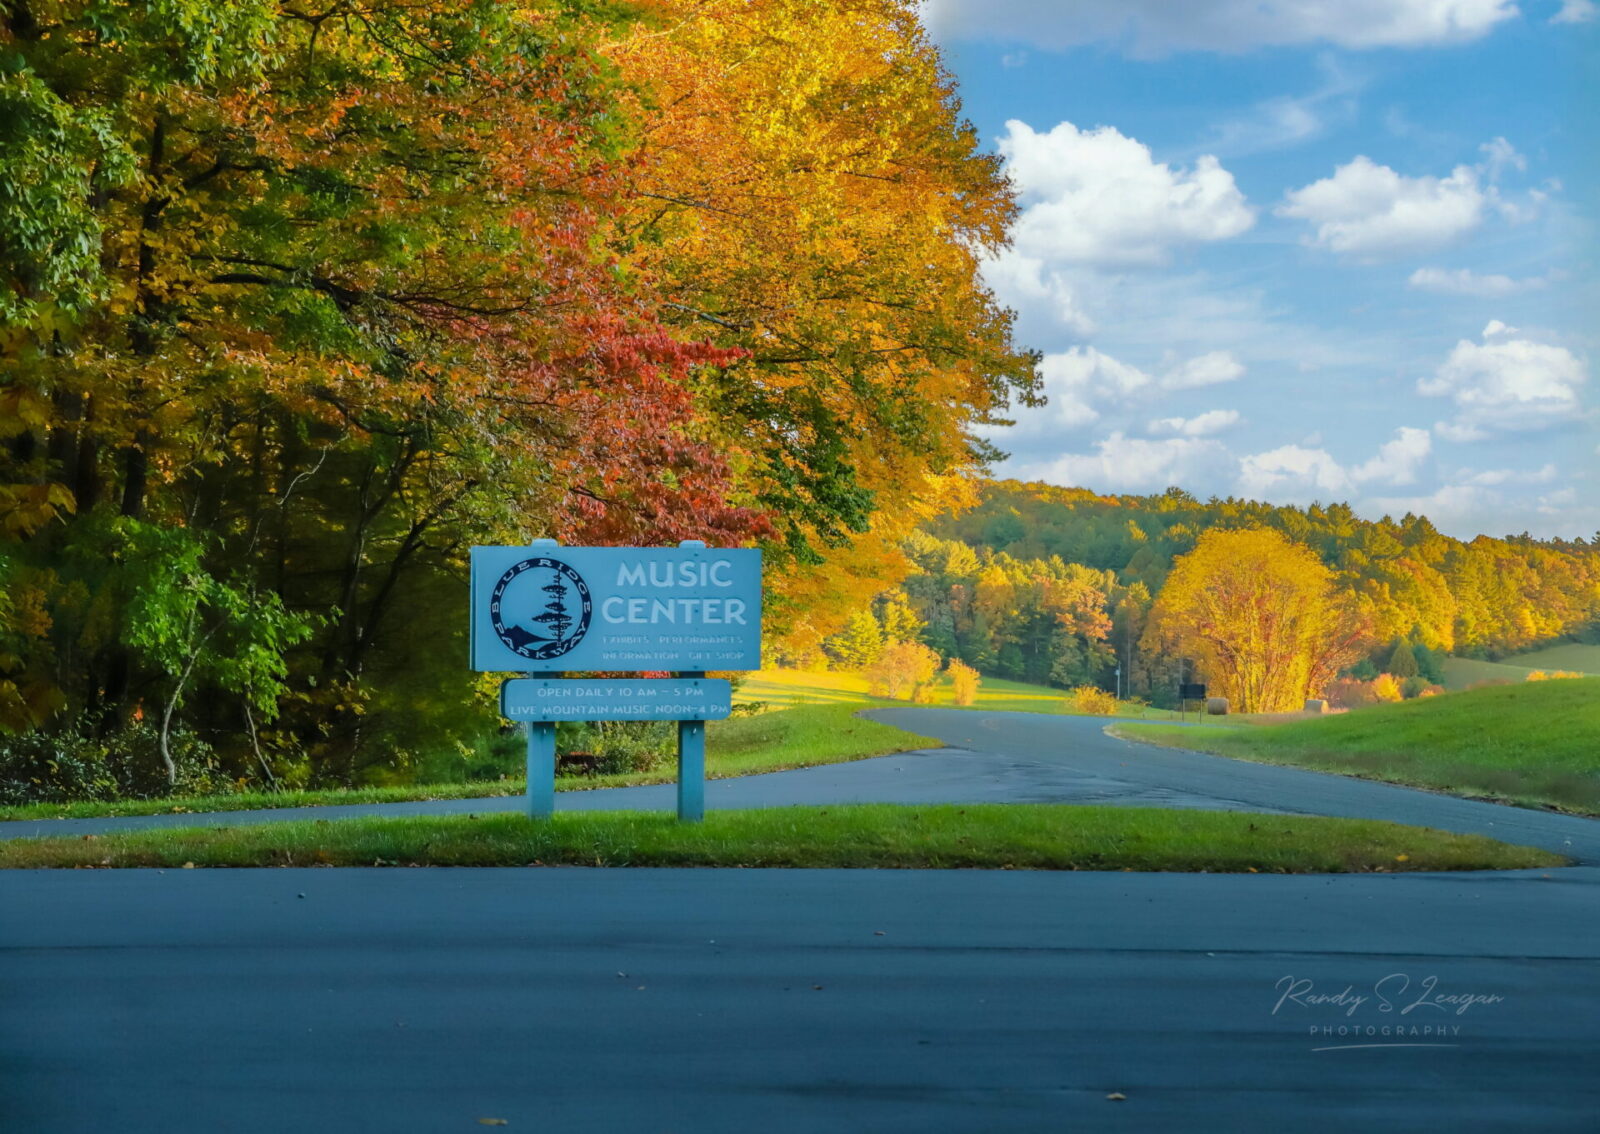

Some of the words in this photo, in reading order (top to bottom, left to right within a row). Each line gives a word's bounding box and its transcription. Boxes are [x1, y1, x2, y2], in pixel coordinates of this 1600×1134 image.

[491, 561, 530, 613] BLUE
[538, 559, 591, 613] RIDGE
[616, 560, 733, 587] MUSIC
[602, 597, 747, 624] CENTER
[495, 621, 586, 658] PARKWAY
[716, 652, 745, 660] SHOP
[537, 687, 571, 697] OPEN
[575, 687, 614, 697] DAILY
[619, 687, 632, 697] 10
[637, 687, 657, 697] AM
[673, 687, 681, 696] 5
[685, 687, 704, 696] PM
[510, 706, 537, 715] LIVE
[543, 705, 609, 715] MOUNTAIN
[613, 705, 650, 714] MUSIC
[711, 704, 728, 713] PM
